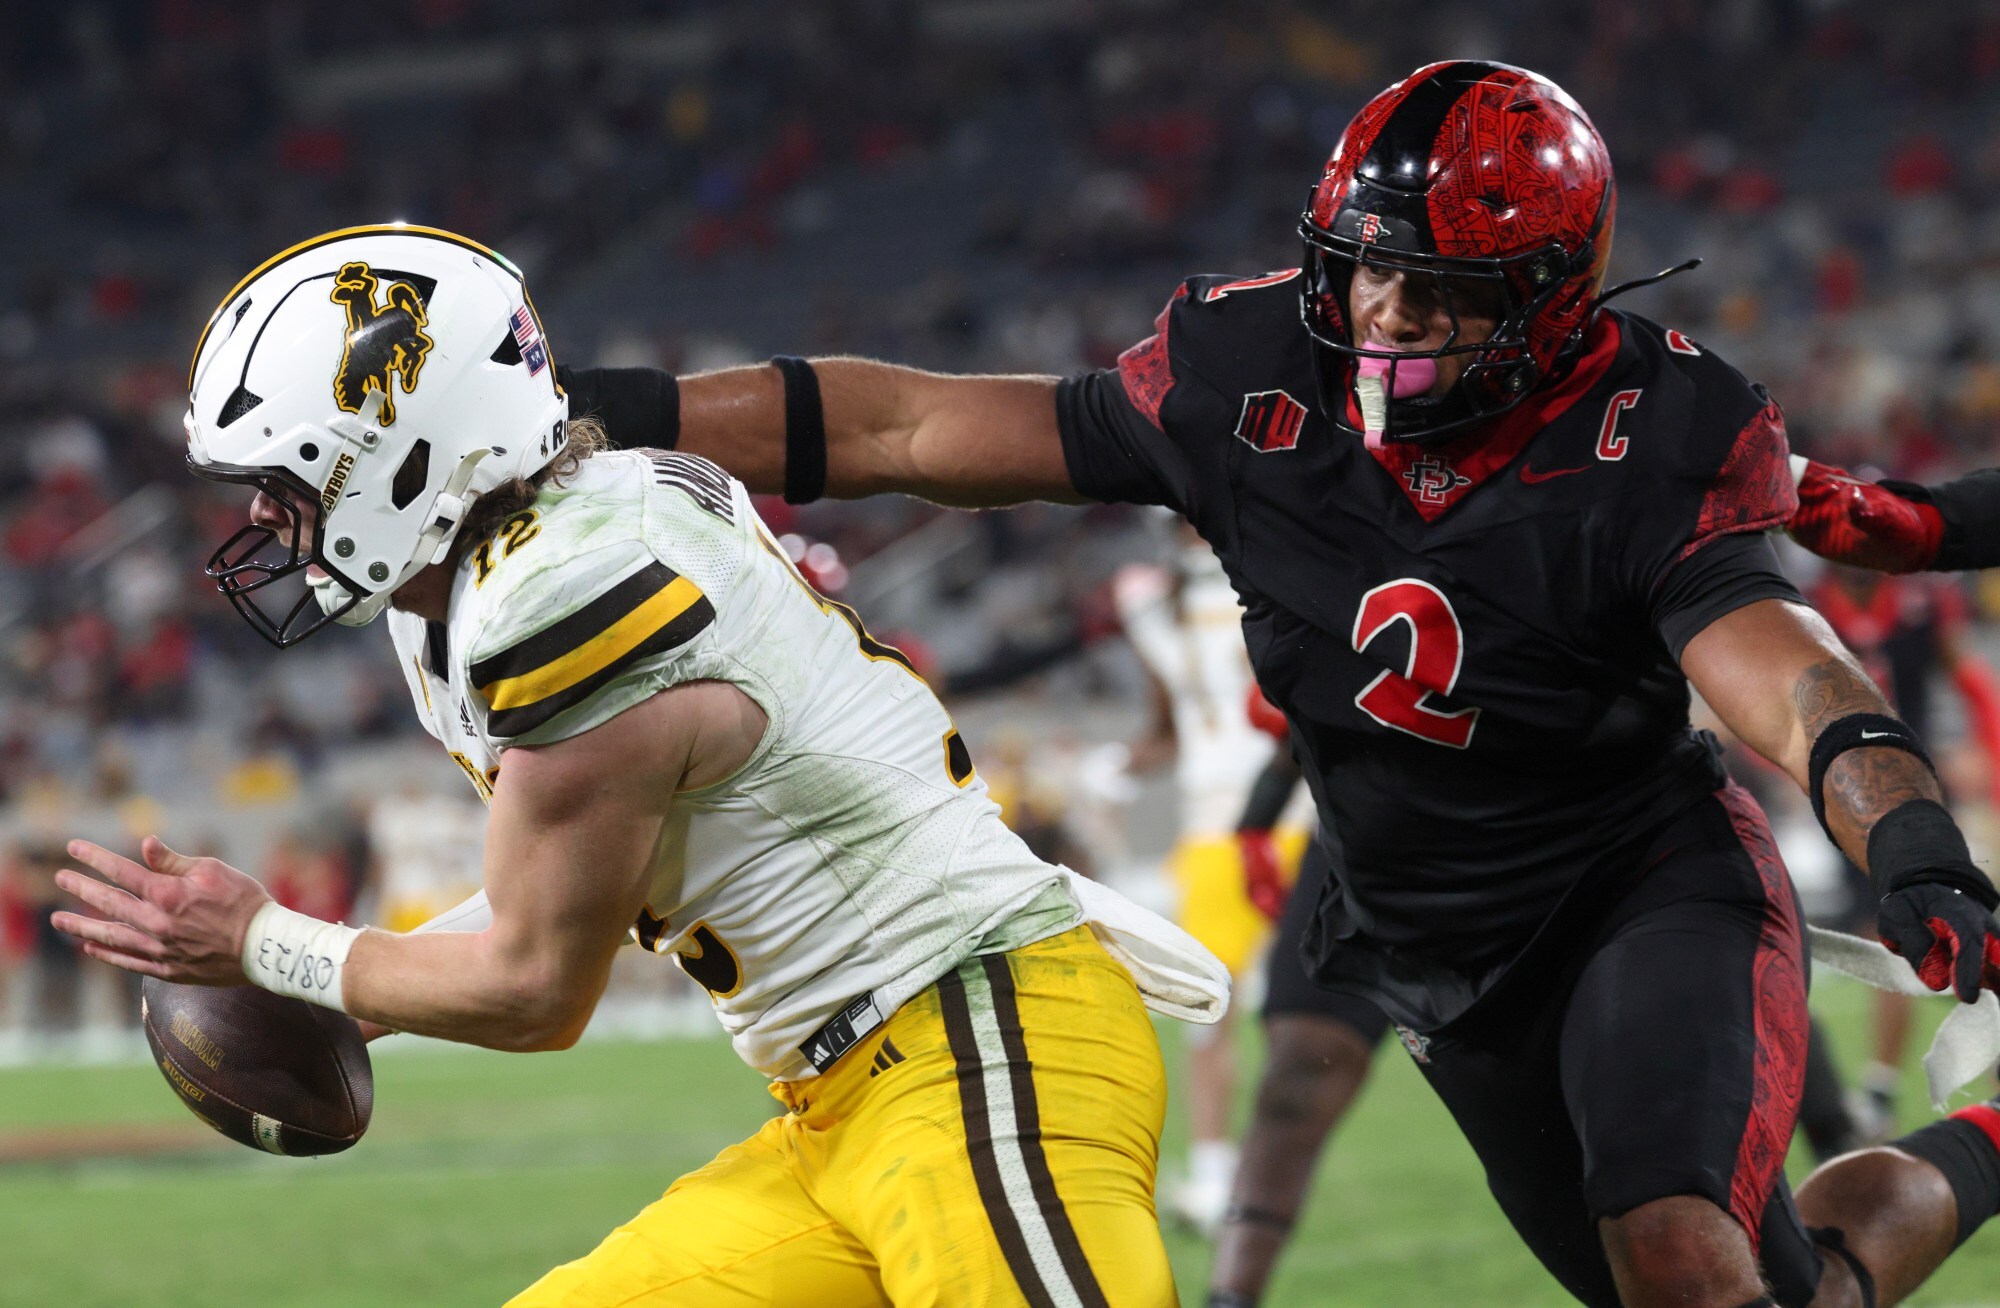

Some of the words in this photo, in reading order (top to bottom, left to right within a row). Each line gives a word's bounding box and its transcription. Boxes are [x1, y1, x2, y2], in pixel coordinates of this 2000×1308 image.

[552, 419, 570, 451] RI
[1595, 388, 1643, 461] C
[471, 508, 543, 592] 12
[1351, 577, 1483, 750] 2
[258, 937, 335, 991] 08/23
[170, 1011, 226, 1072] WYOMING
